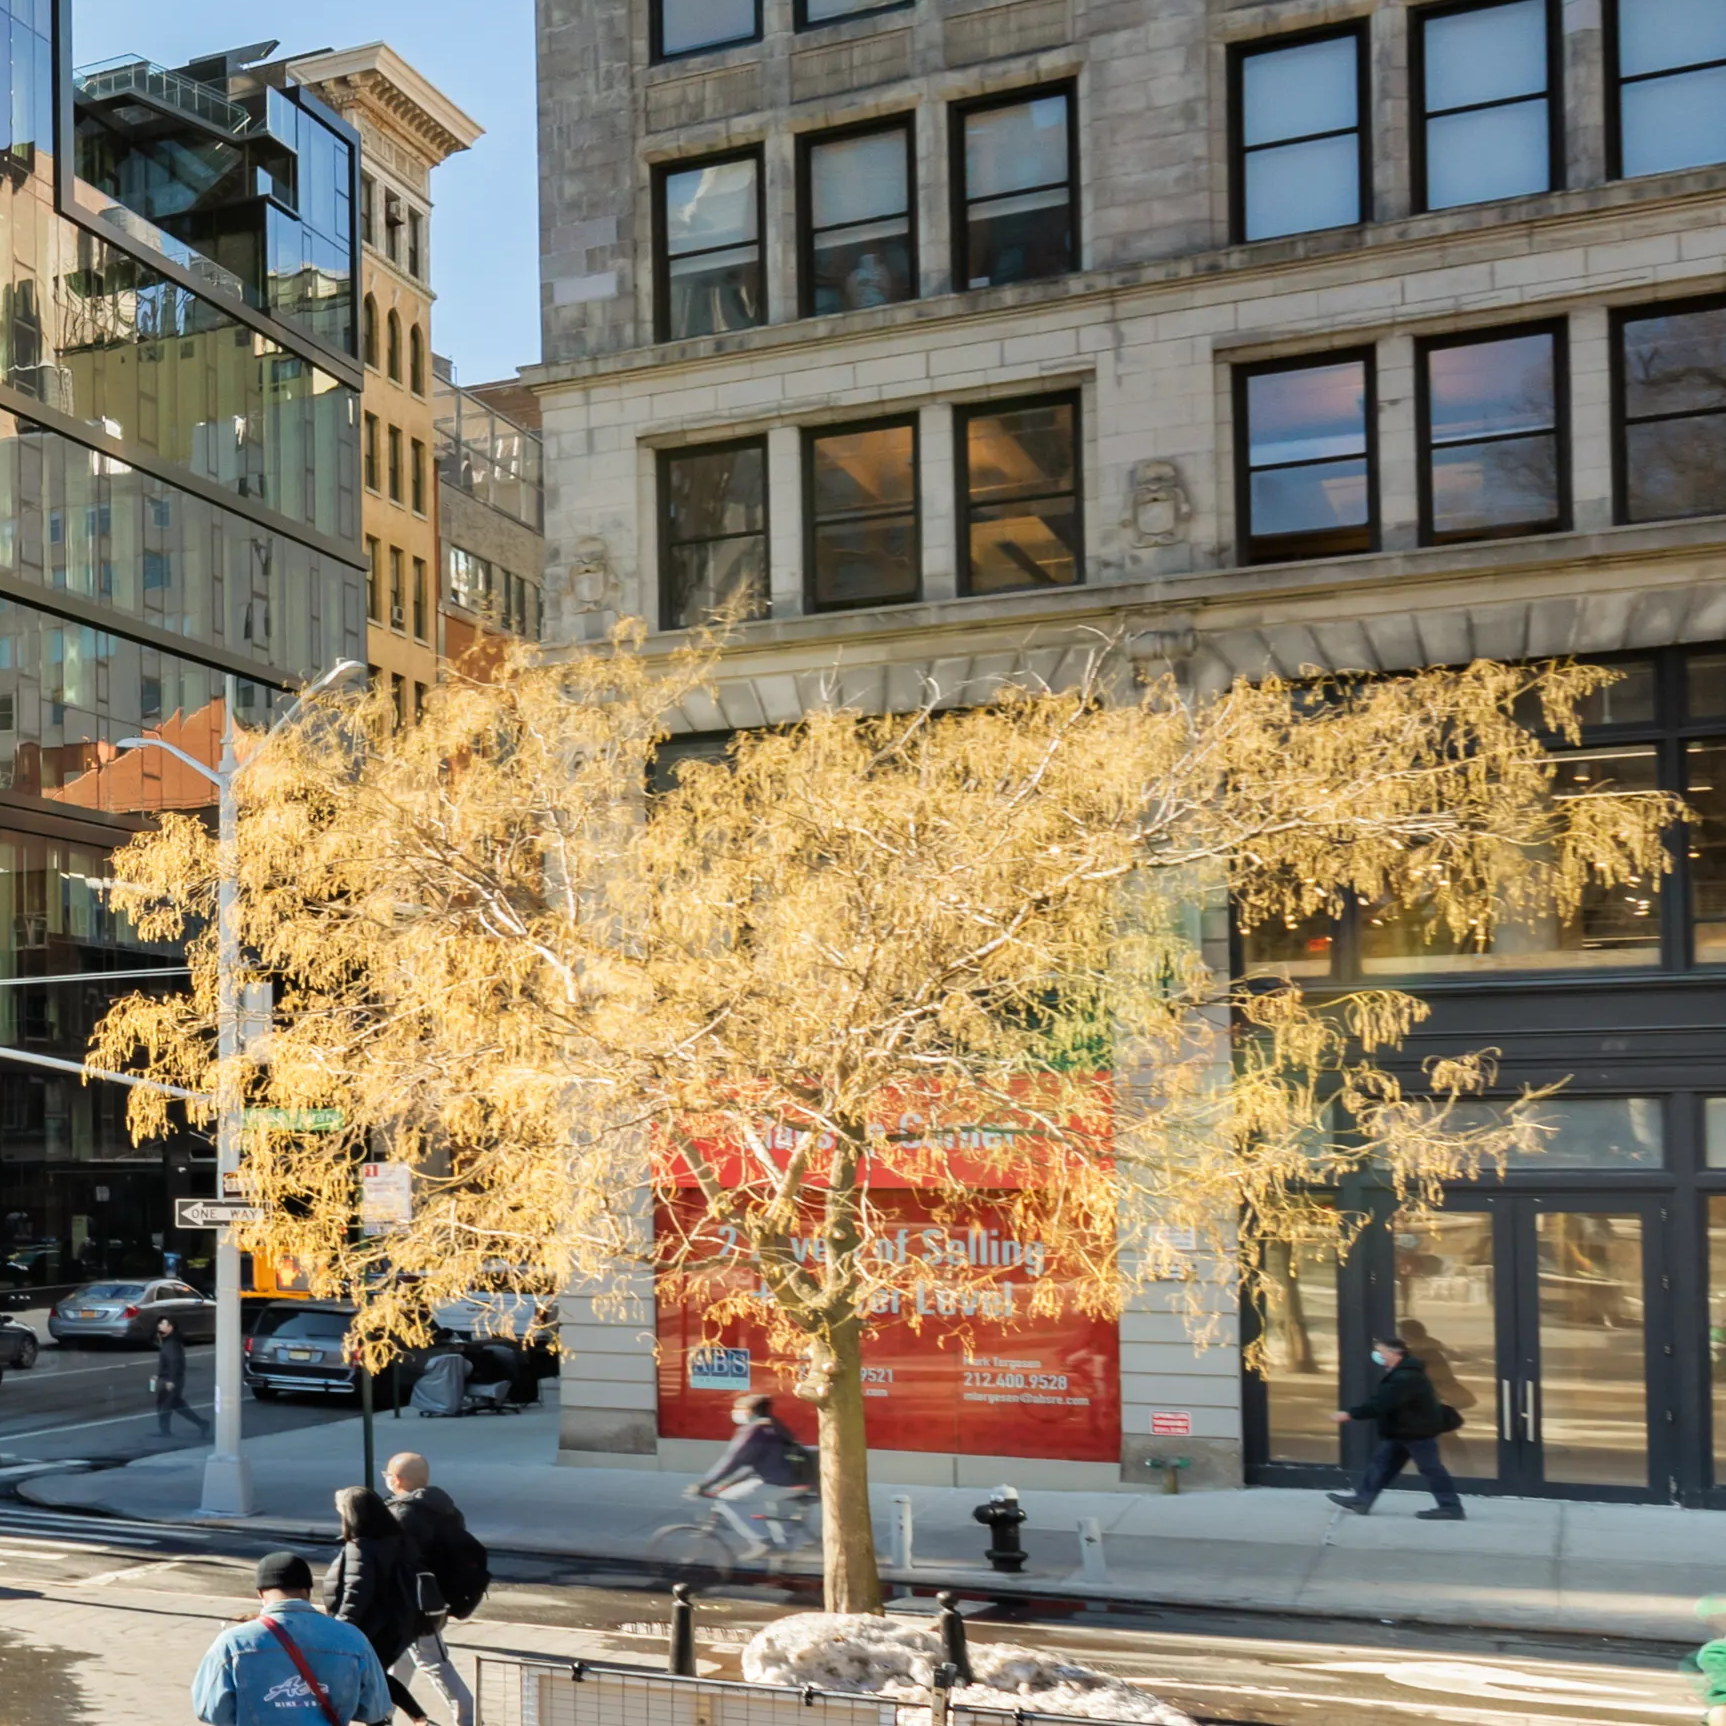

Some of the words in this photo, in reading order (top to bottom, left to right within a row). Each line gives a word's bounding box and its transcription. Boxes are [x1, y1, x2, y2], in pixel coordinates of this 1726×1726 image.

[191, 1209, 218, 1219] ONE
[230, 1209, 258, 1220] WAY
[922, 1229, 1045, 1275] Selling
[963, 1372, 1068, 1390] 212.400.9528
